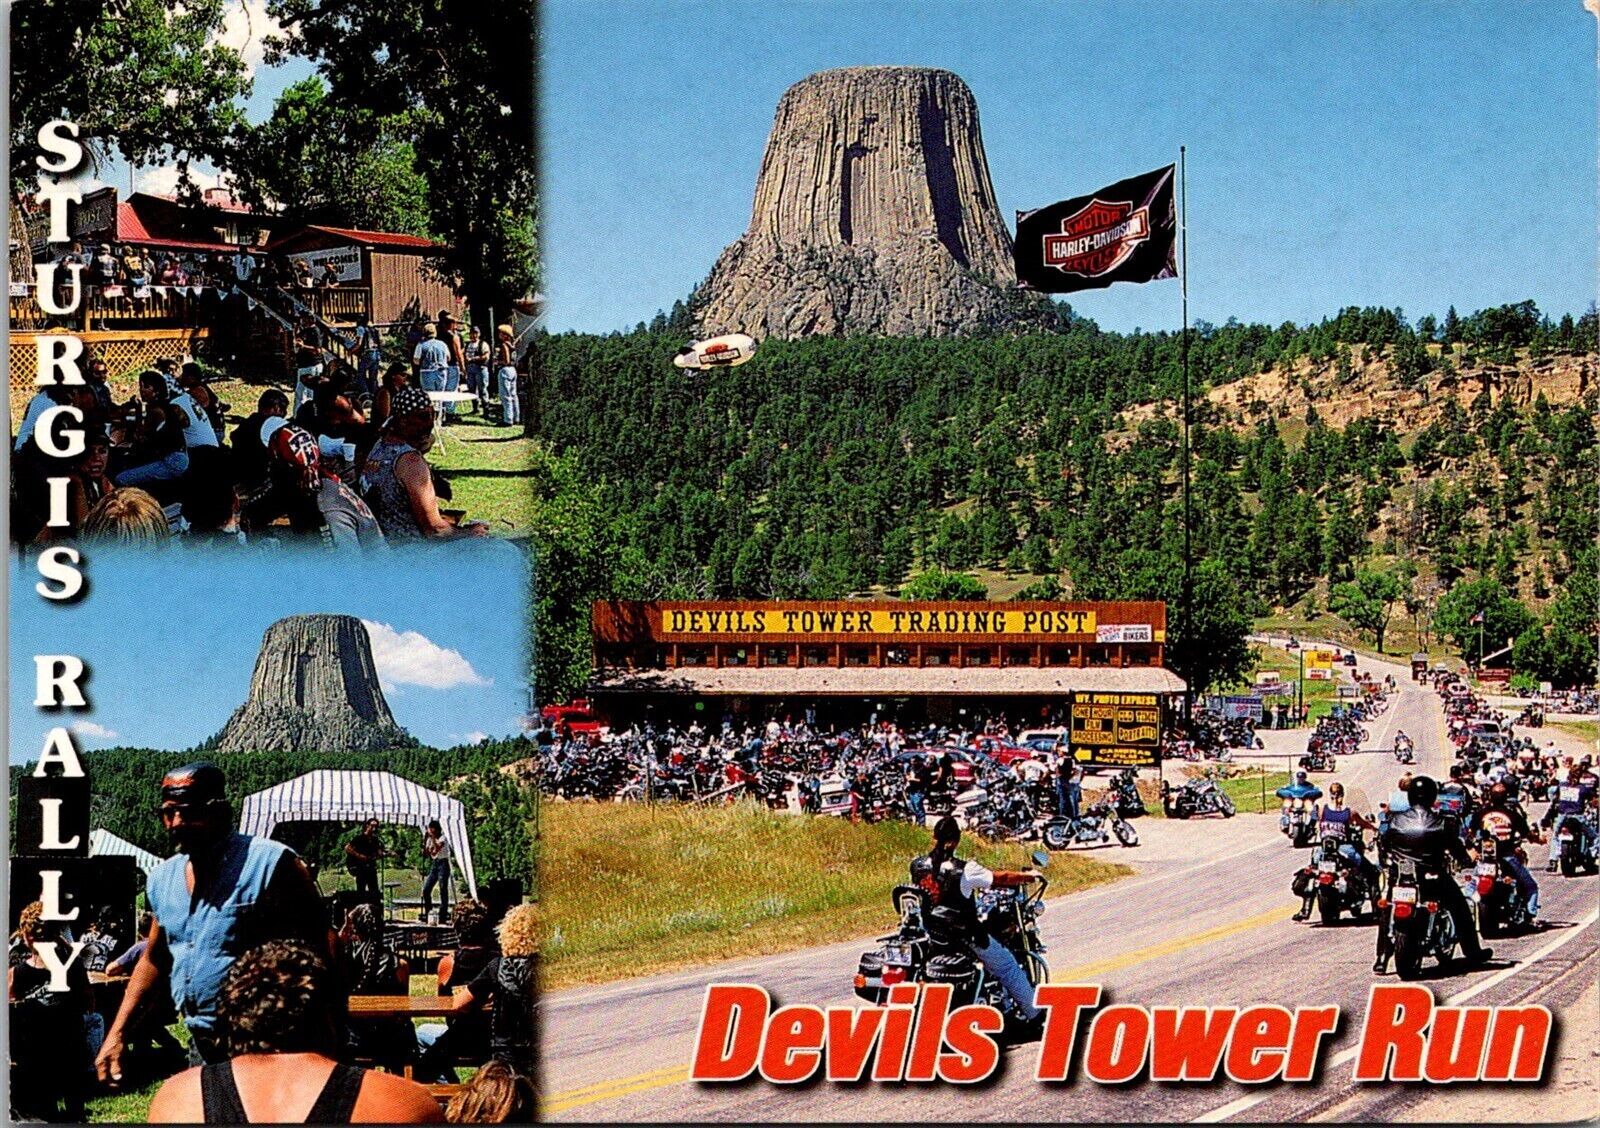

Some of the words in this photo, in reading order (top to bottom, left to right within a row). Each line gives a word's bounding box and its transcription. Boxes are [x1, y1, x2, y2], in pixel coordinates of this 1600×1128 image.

[1073, 208, 1122, 233] MOTOR
[1052, 217, 1142, 259] HARLEY-DAVIDSON
[671, 610, 766, 633] DEVILS
[783, 610, 873, 633] TOWER
[889, 611, 1006, 633] TRADING
[1023, 611, 1088, 633] POST
[1122, 631, 1149, 641] BIKERS
[1093, 694, 1120, 705] PHOTO
[1121, 695, 1157, 705] EXPRESS
[1073, 706, 1091, 718] ONE
[1092, 707, 1114, 719] HOUR
[1072, 730, 1113, 744] PROCESSING
[1119, 726, 1157, 741] PORTRAITS
[1099, 749, 1151, 757] CAMERAS
